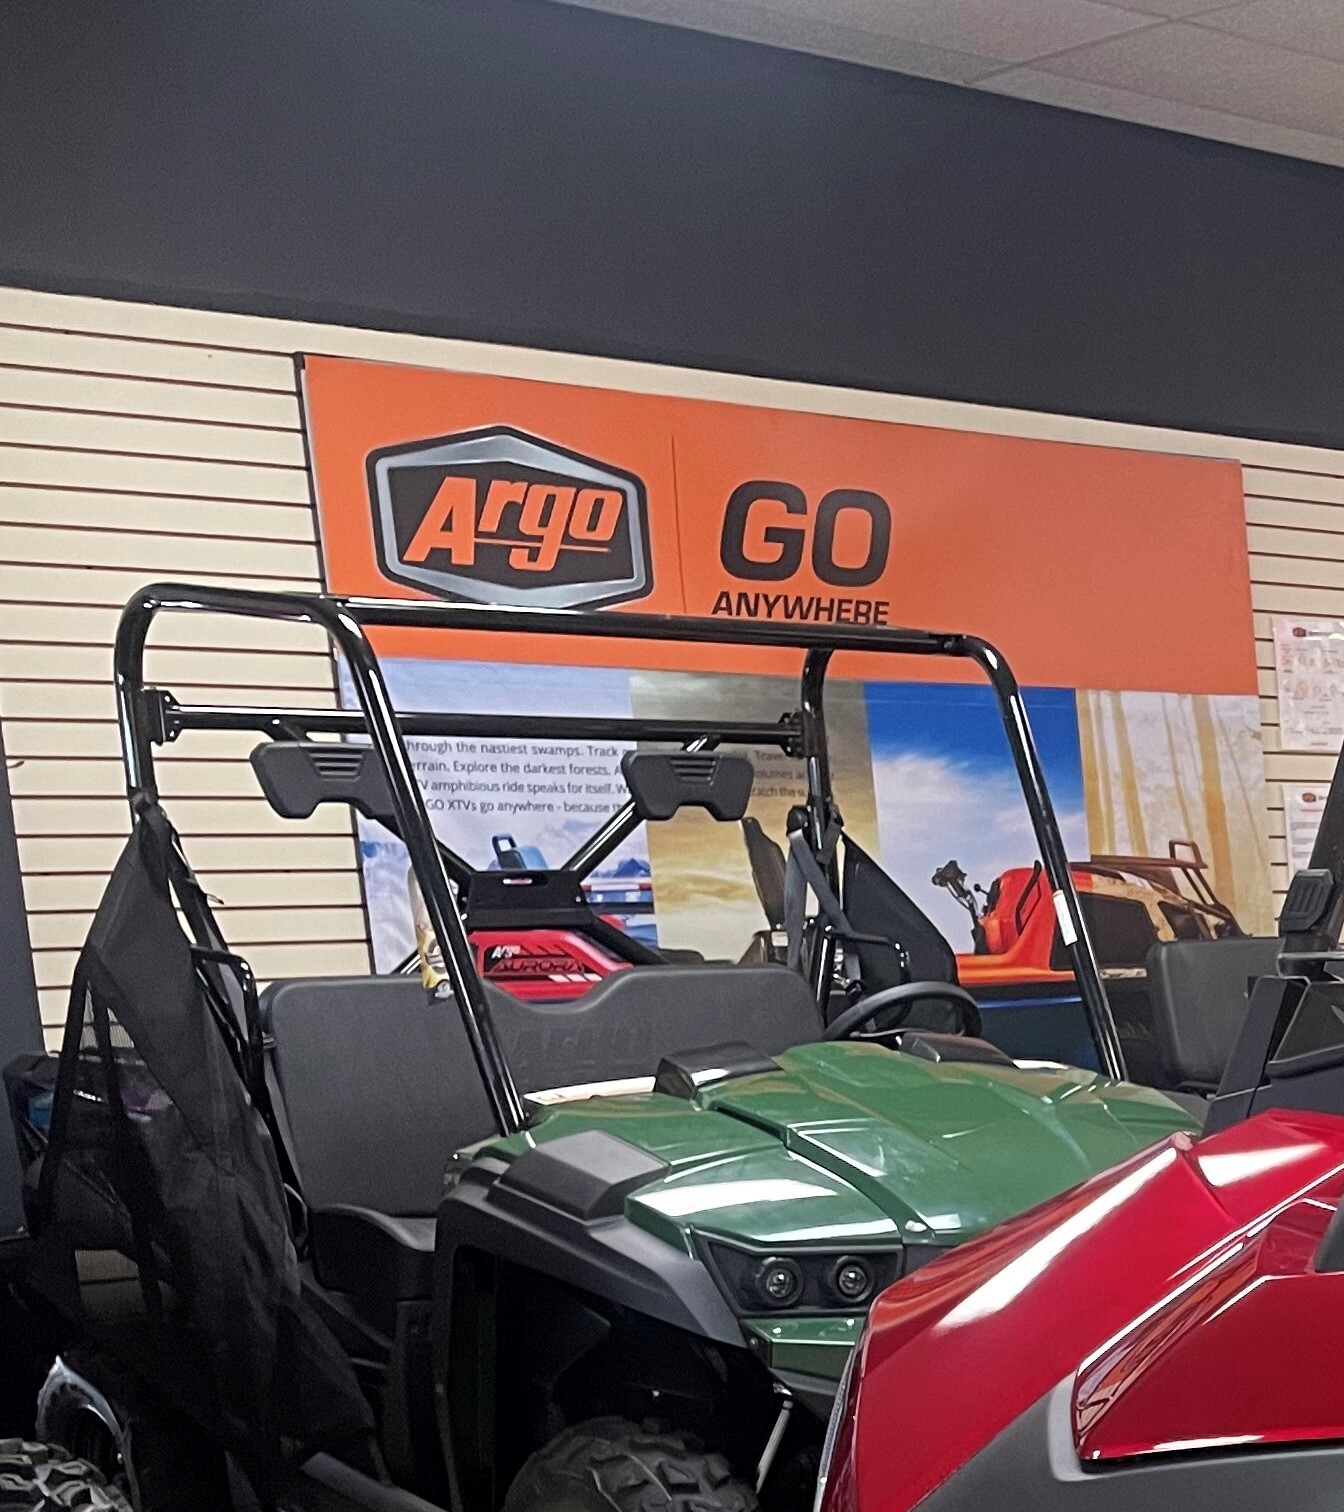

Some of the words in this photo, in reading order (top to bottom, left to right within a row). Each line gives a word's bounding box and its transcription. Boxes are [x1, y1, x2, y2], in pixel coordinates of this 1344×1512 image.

[403, 476, 623, 571] Argo
[719, 480, 892, 587] GO
[711, 591, 890, 626] ANYWHERE
[405, 740, 452, 755] hrough
